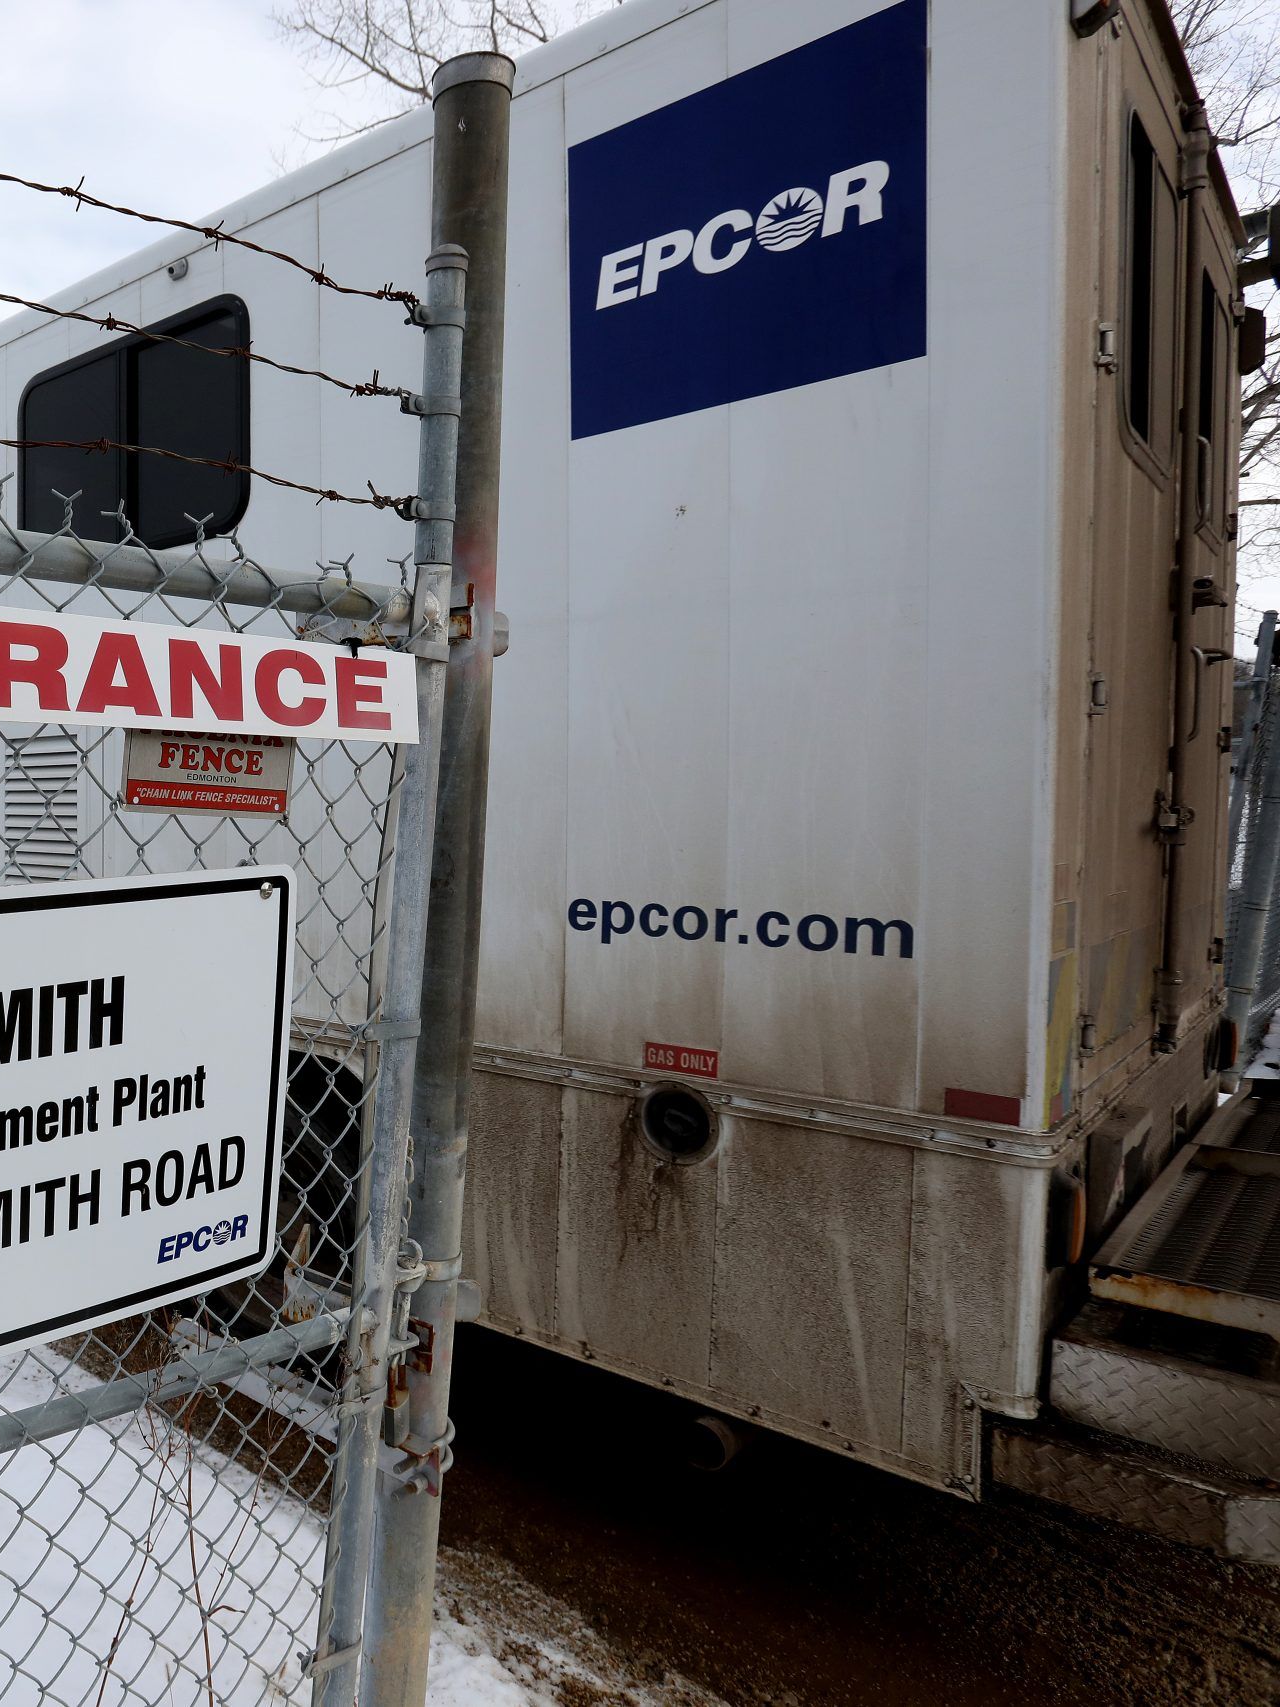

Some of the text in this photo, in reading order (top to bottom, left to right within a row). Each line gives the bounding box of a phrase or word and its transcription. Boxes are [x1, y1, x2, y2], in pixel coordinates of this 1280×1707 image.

[595, 160, 890, 311] EPCOR
[158, 742, 263, 776] FENCE
[186, 773, 237, 784] EDMONTON
[171, 789, 193, 801] LINK
[195, 791, 223, 803] FENCE
[568, 898, 915, 959] epcor.com
[647, 1047, 715, 1072] GAS ONLY
[112, 1065, 206, 1127] Plant
[120, 1135, 246, 1217] ROAD
[157, 1214, 249, 1264] EPCOR
